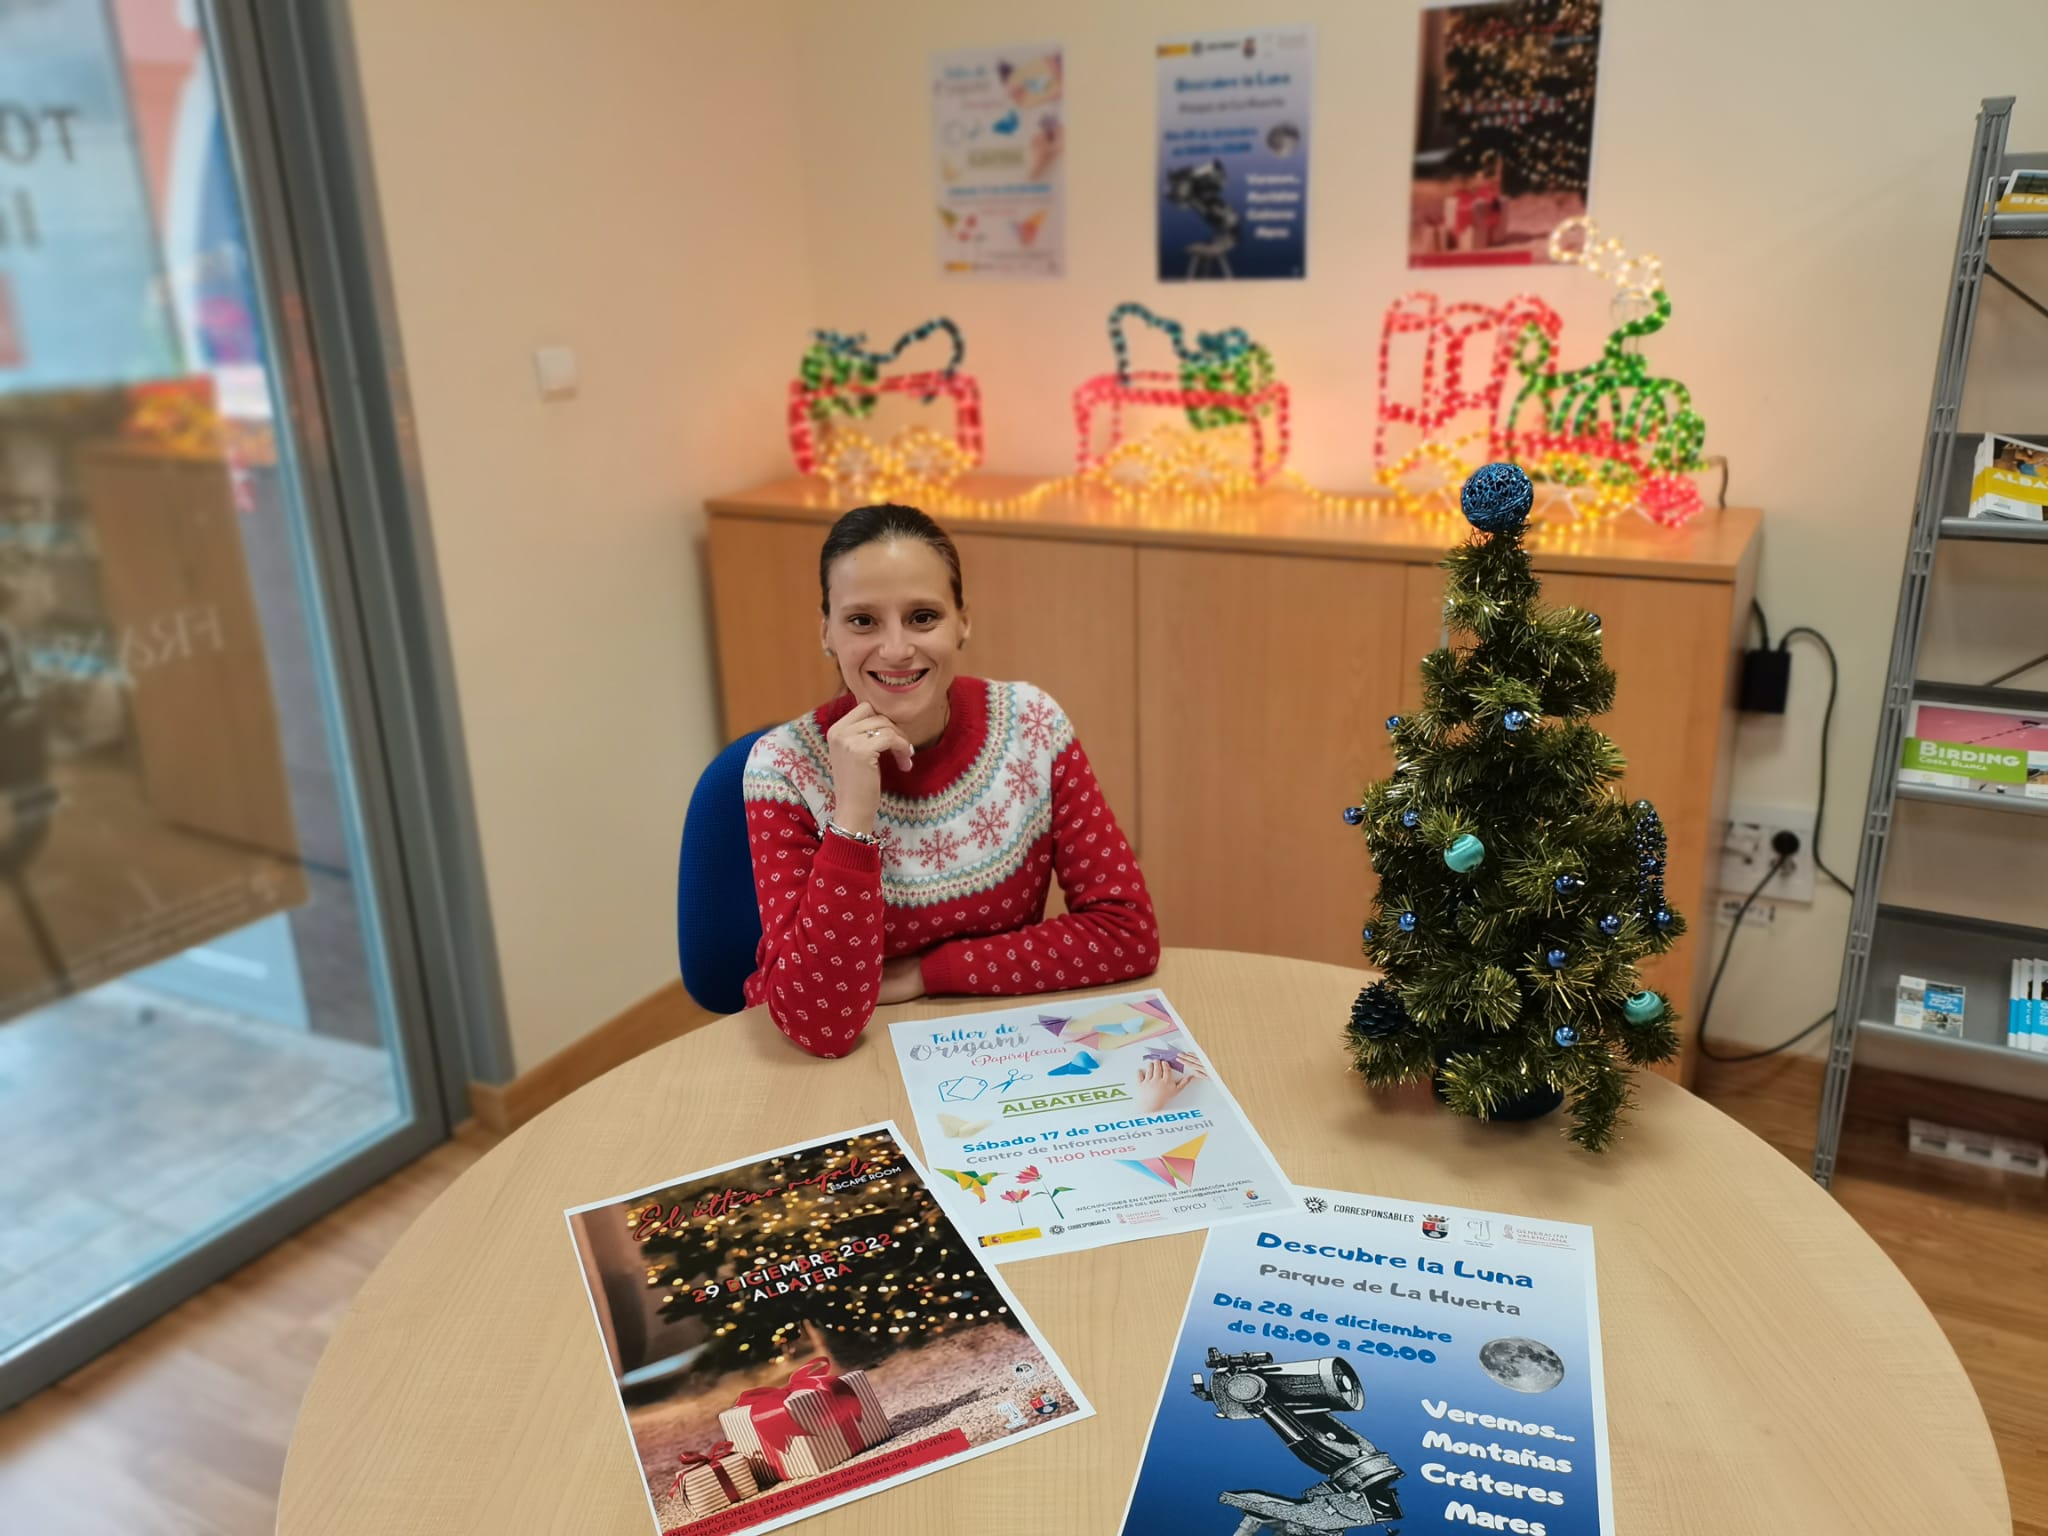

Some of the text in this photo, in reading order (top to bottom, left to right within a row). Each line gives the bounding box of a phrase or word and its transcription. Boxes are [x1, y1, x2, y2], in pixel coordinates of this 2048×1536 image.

[1992, 471, 2048, 490] ALBA
[1919, 740, 2021, 768] BIRDING
[909, 1032, 1031, 1062] Origami
[929, 1023, 1020, 1046] Taller de
[1001, 1087, 1128, 1115] ALBATERA
[962, 1108, 1205, 1154] Sábado 17 de DICIEMBRE
[965, 1118, 1215, 1166] Centro de Información Juvenil
[1045, 1144, 1138, 1166] 11:00 horas
[631, 1203, 689, 1242] El
[787, 1155, 876, 1194] regalo
[829, 1165, 902, 1192] ESCAPE ROOM
[1332, 1203, 1416, 1224] CORRESPONSABLES
[691, 1233, 894, 1304] 29 DICIEMBRE 2022
[752, 1262, 853, 1303] ALBATERA
[1256, 1231, 1535, 1289] Descubre la Luna
[1259, 1263, 1522, 1317] Parque de La Huerta
[1213, 1292, 1454, 1344] Día 28 de diciembre
[1226, 1319, 1437, 1365] de 18:00 a 20:00
[1420, 1398, 1577, 1443] Veremos...
[776, 1481, 822, 1504] CENTRO
[823, 1475, 839, 1485] DE
[915, 1433, 957, 1452] JUVENIL
[1421, 1429, 1574, 1474] Montañas
[1419, 1462, 1565, 1507] Cráteres
[1443, 1500, 1548, 1536] Mares
